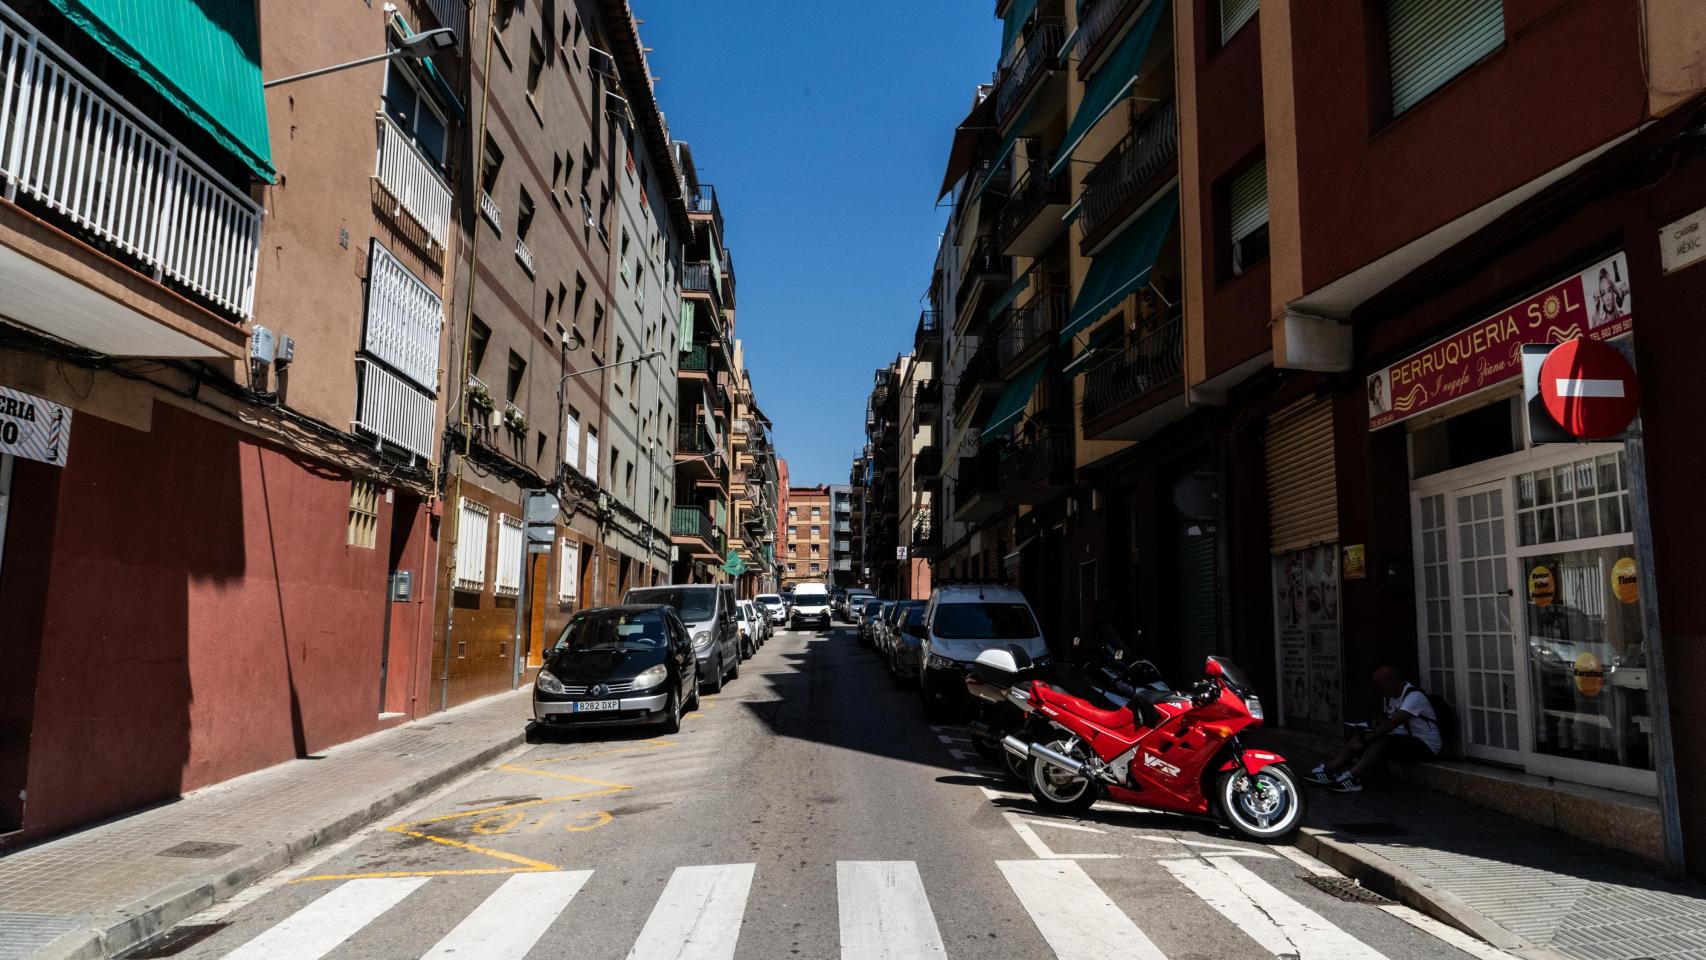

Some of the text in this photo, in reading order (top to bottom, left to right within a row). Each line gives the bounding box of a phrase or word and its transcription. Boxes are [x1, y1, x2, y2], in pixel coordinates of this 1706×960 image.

[1391, 315, 1520, 389] PERRUQUERIA
[1527, 289, 1580, 328] SOL
[579, 700, 617, 711] 8282 DXP
[1144, 752, 1181, 778] VFR
